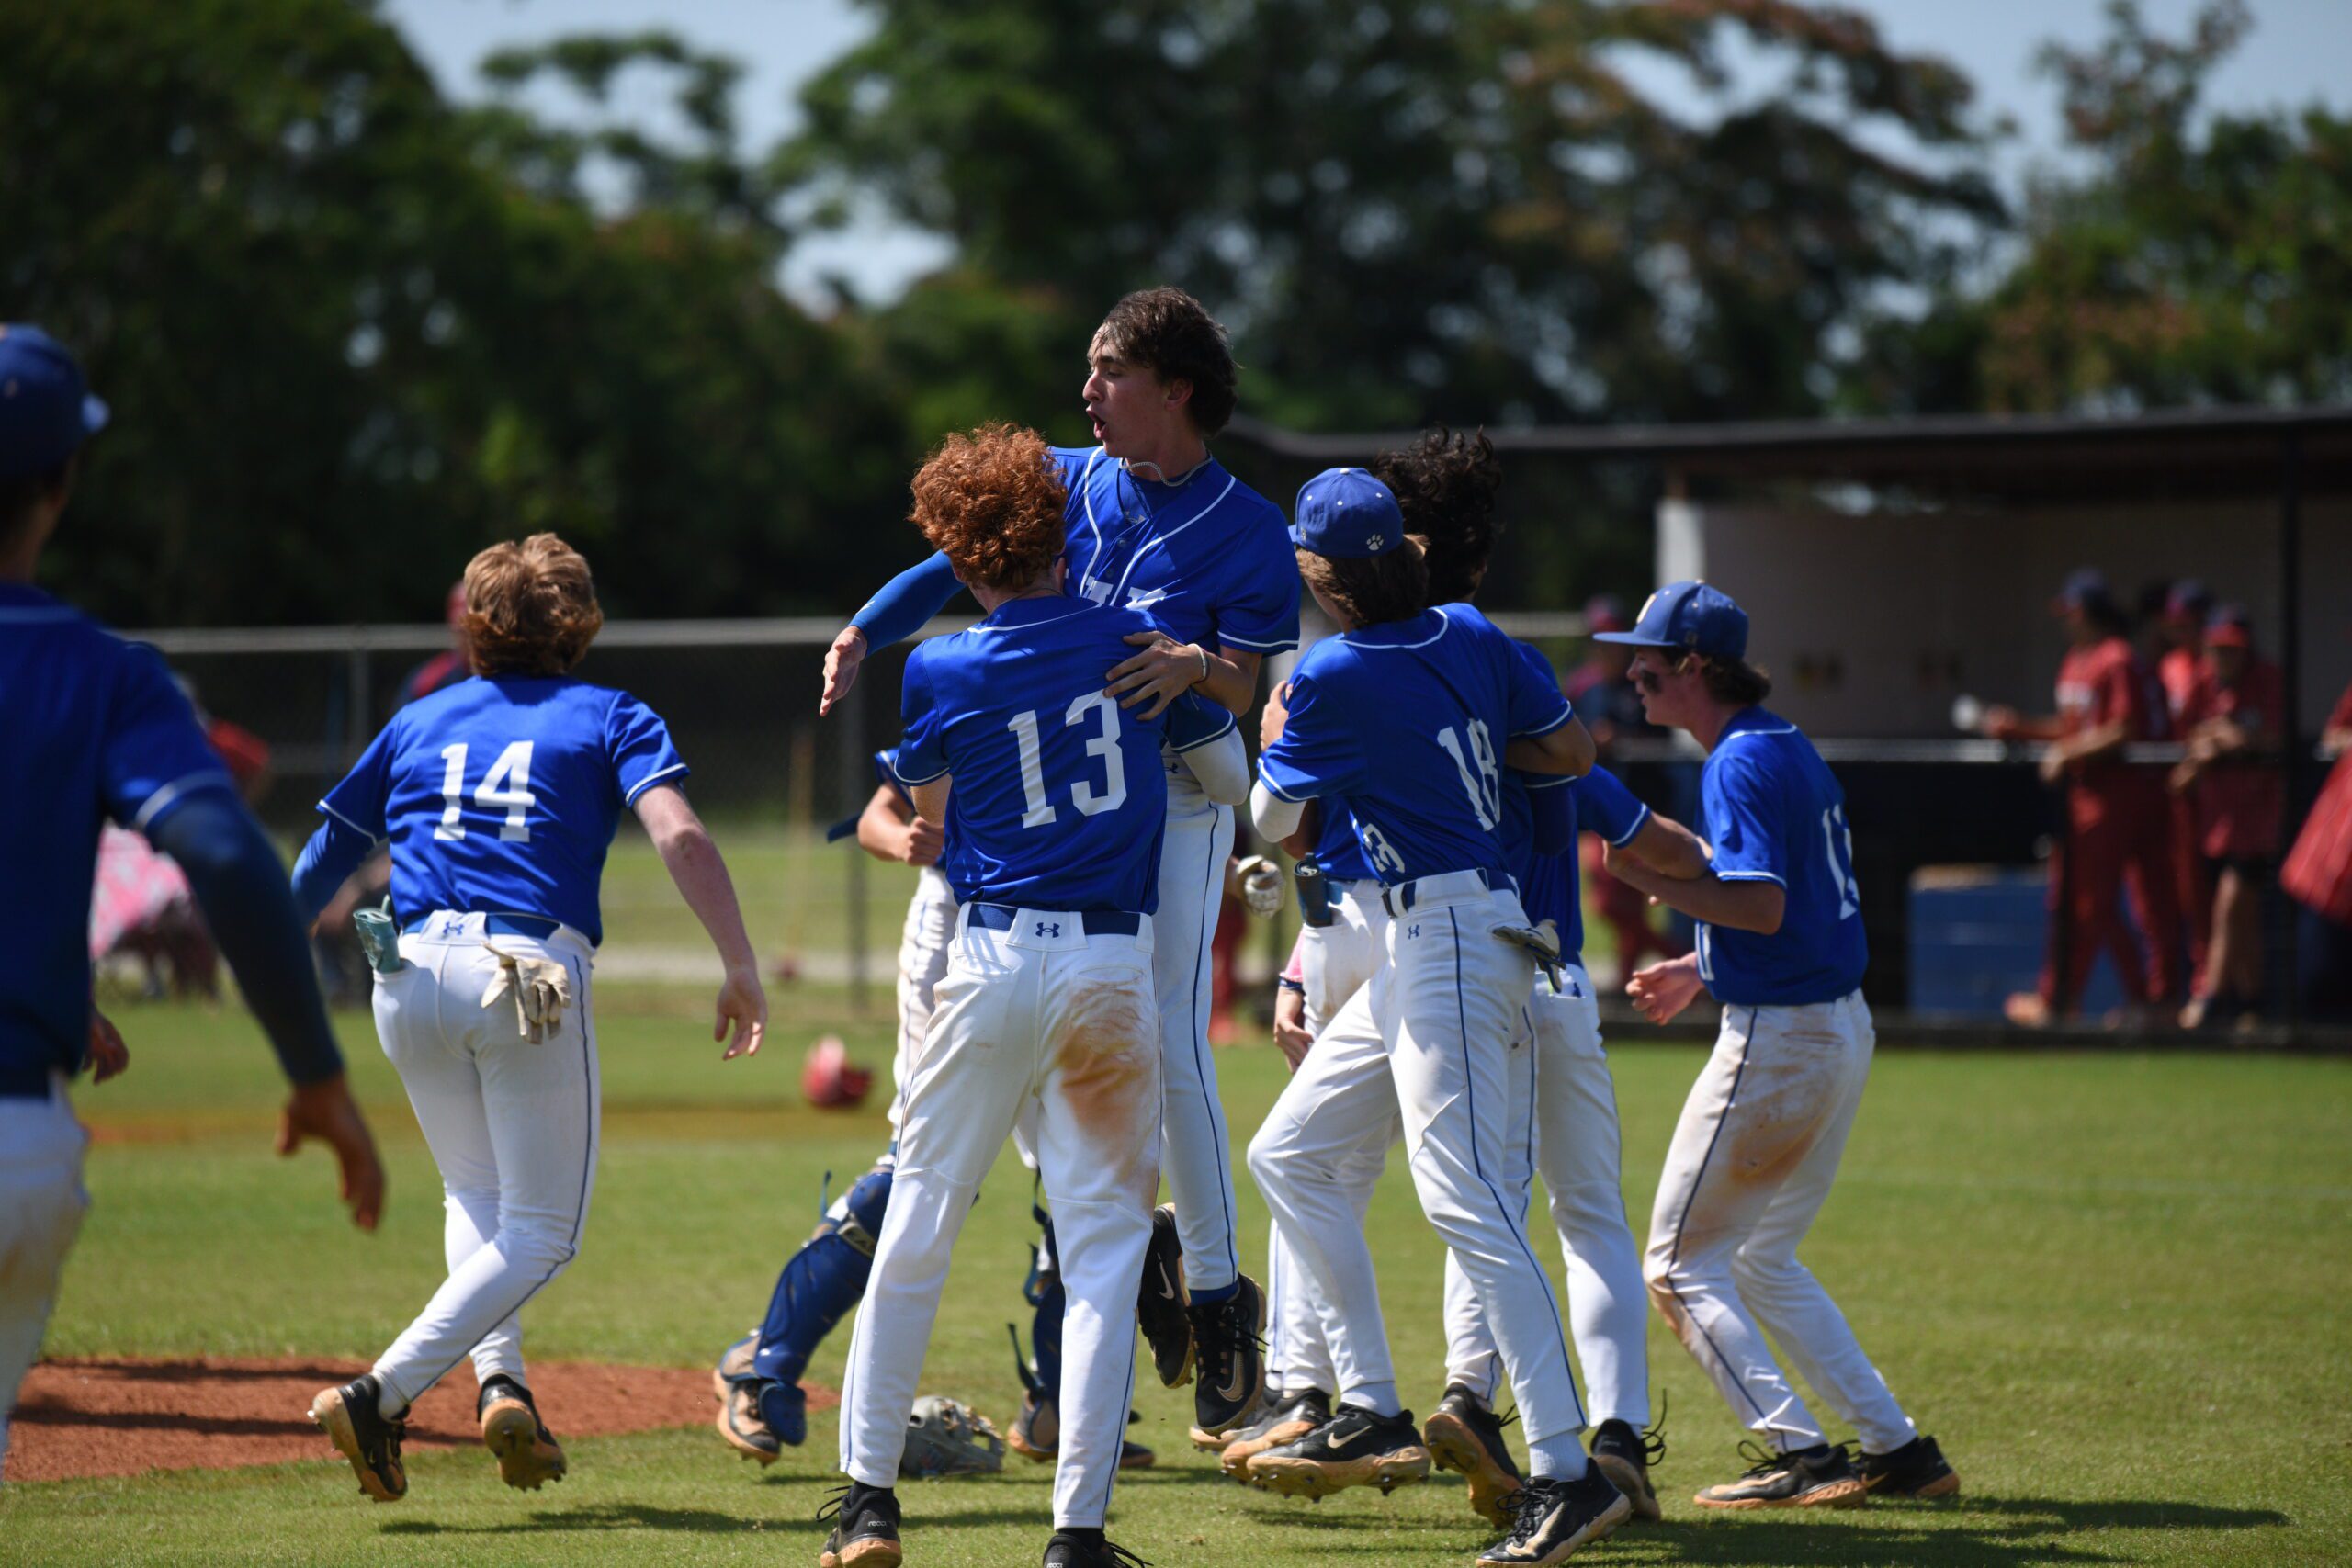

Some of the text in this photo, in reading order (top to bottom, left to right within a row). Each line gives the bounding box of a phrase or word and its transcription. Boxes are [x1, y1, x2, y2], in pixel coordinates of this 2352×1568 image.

[433, 739, 536, 843] 14
[1007, 689, 1128, 829] 13
[1437, 718, 1501, 832] 18
